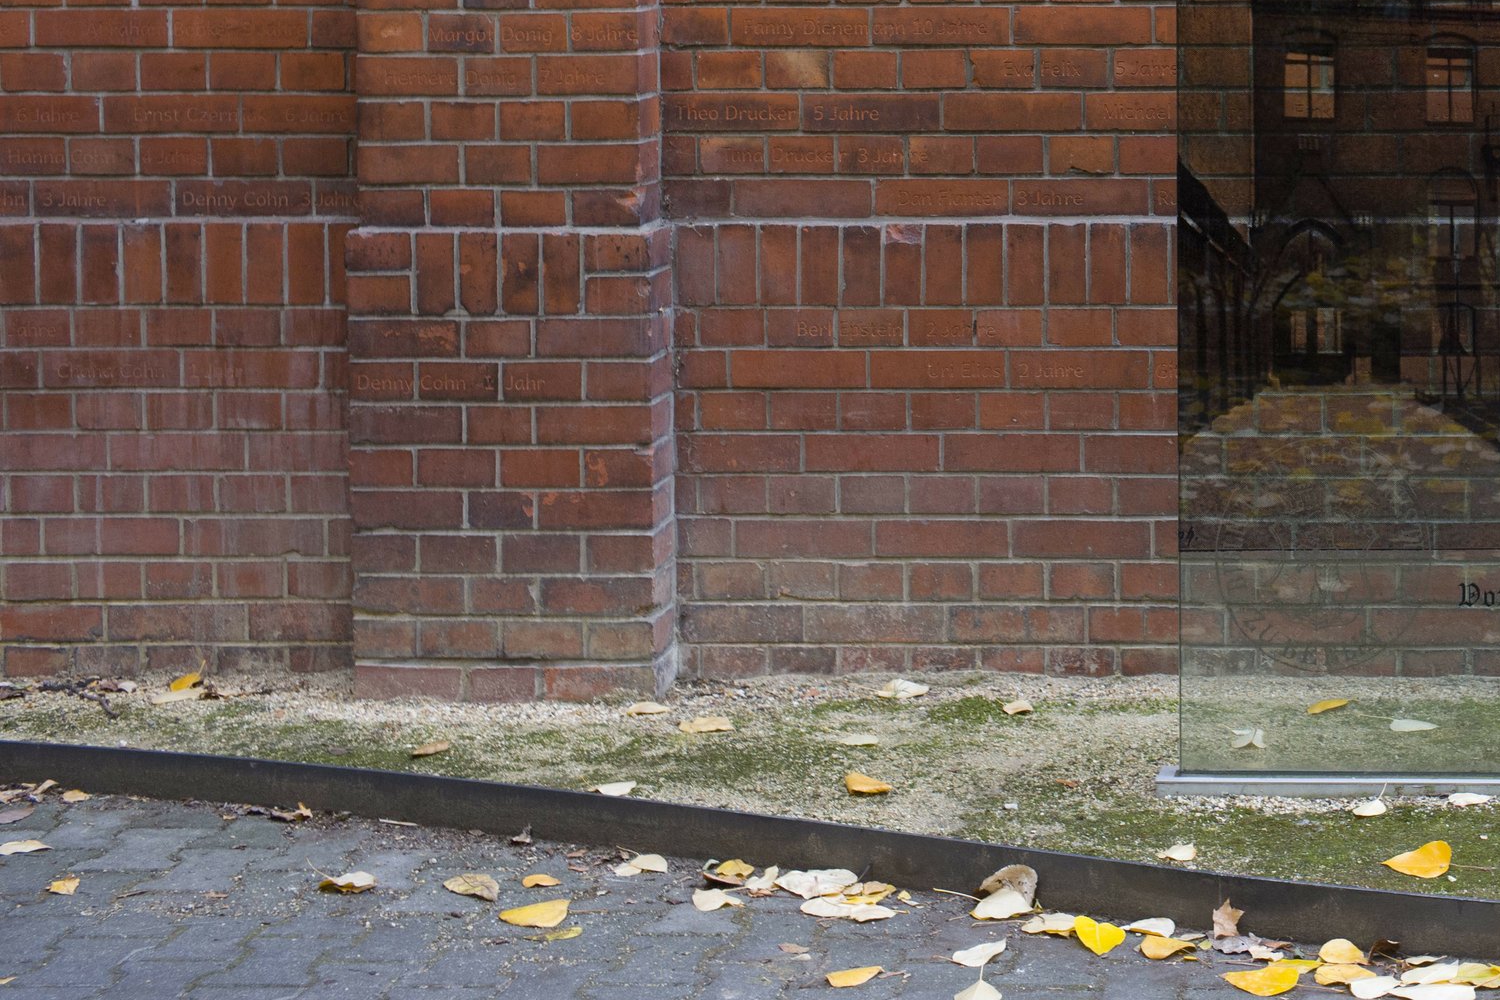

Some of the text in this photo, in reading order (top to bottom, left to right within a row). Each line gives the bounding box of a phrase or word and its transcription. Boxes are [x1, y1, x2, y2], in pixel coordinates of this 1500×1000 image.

[586, 26, 638, 42] Jahre
[675, 104, 719, 121] Theo
[726, 104, 798, 121] Drucker
[829, 104, 880, 121] Jahre
[182, 191, 237, 210] Denny
[243, 191, 289, 207] Cohn
[1033, 190, 1084, 206] Jahre
[356, 375, 413, 395] Denny
[420, 374, 466, 391] Cohn
[504, 374, 546, 391] Jahr
